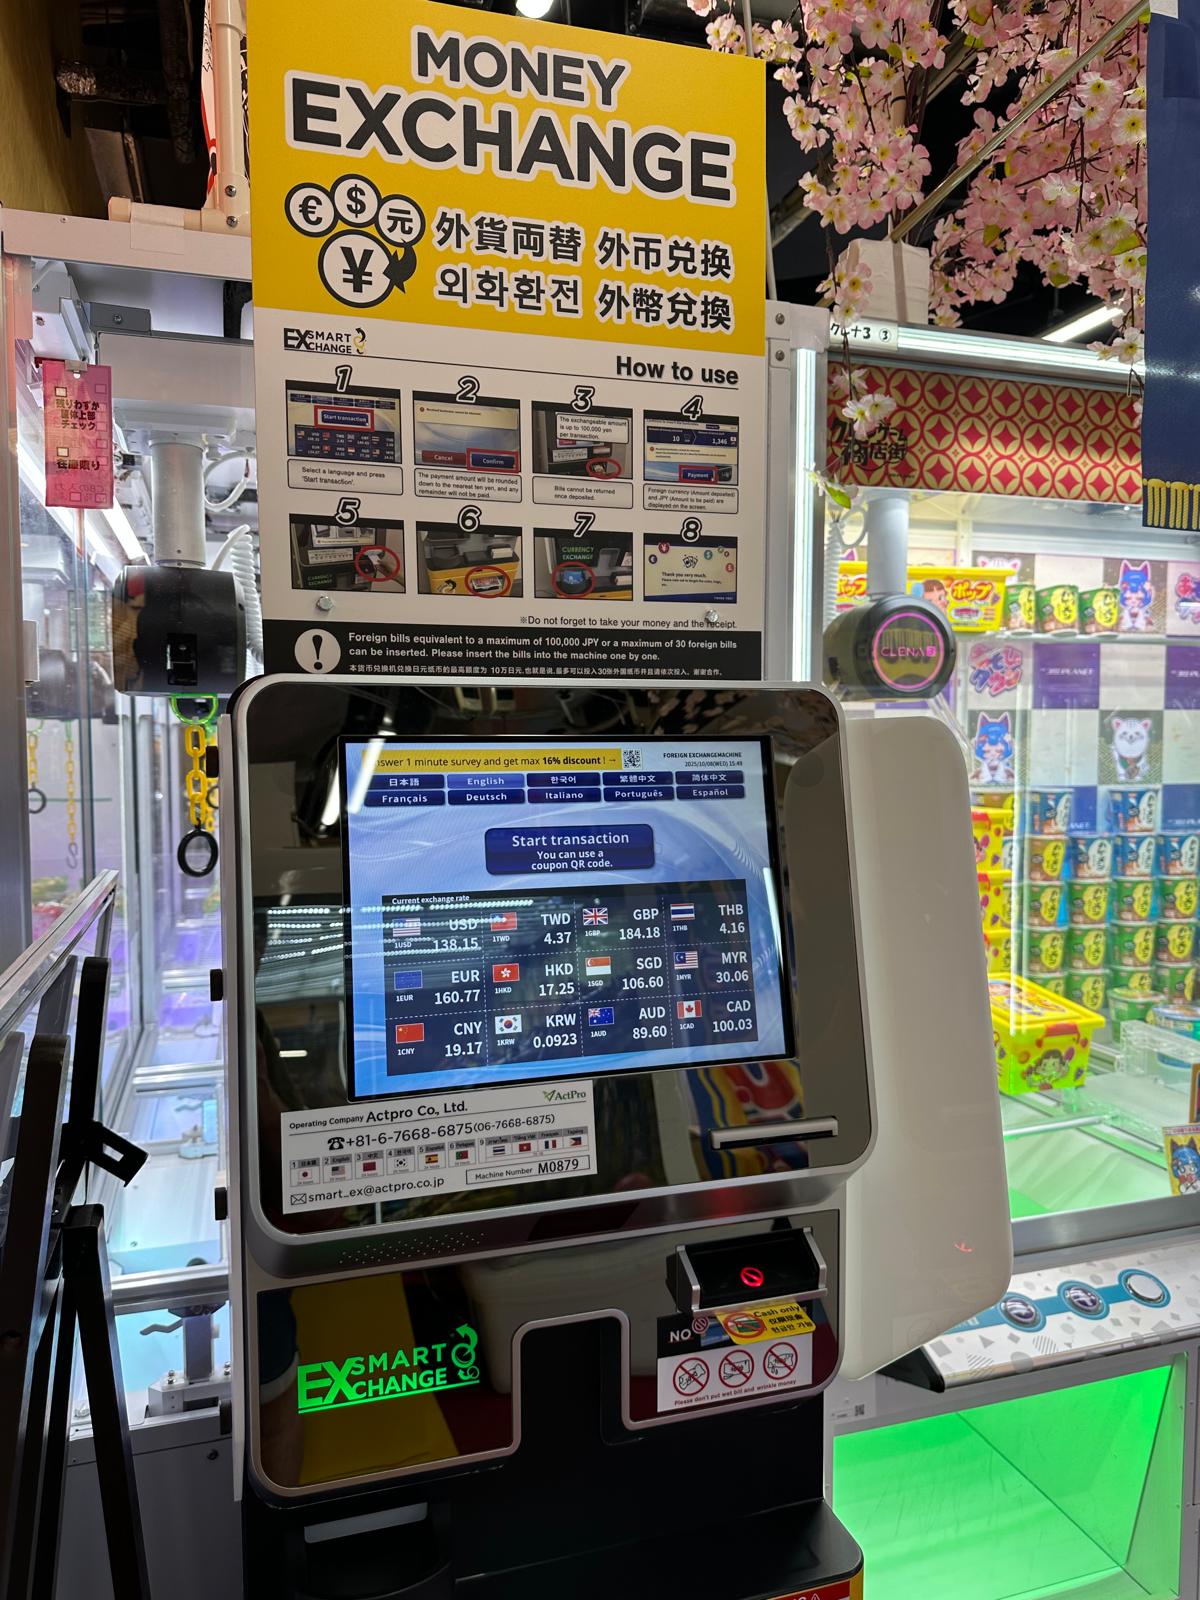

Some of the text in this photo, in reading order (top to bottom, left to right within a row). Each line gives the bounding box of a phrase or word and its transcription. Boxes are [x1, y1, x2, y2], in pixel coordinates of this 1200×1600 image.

[417, 31, 625, 106] MONEY
[292, 77, 731, 201] EXCHANGE
[384, 207, 414, 235] 元
[436, 211, 732, 280] 外貨両替 外币兑换
[437, 267, 580, 315] 외화환전
[598, 284, 732, 330] 外幣兌換
[308, 330, 351, 343] SMART
[616, 356, 739, 385] How to use
[336, 365, 352, 391] 1
[457, 376, 479, 402] 2
[572, 386, 594, 411] 3
[681, 395, 703, 420] 4
[336, 497, 360, 525] 5
[458, 505, 481, 532] 6
[574, 512, 595, 538] 7
[681, 517, 702, 542] 8
[952, 580, 993, 601] ポップ
[544, 617, 557, 625] not
[561, 617, 586, 628] forget
[589, 618, 597, 626] to
[600, 618, 619, 627] take
[621, 620, 640, 629] your
[643, 620, 670, 629] money
[673, 619, 689, 628] and
[692, 620, 705, 628] the
[706, 621, 737, 630] receipt.
[349, 632, 387, 644] Foreign
[390, 633, 410, 644] bills
[413, 634, 463, 645] equivalent
[465, 636, 475, 645] to
[486, 636, 531, 646] maximum
[533, 637, 544, 646] of
[545, 638, 580, 648] 100,000
[582, 638, 599, 647] JPY
[613, 640, 619, 648] a
[621, 638, 662, 648] maximum
[664, 638, 674, 648] of
[676, 639, 686, 648] 30
[688, 640, 718, 650] foreign
[720, 640, 738, 649] bills
[349, 648, 368, 656] can
[370, 648, 383, 656] be
[386, 648, 429, 658] inserted.
[431, 649, 463, 658] Please
[466, 649, 492, 658] insert
[495, 650, 508, 659] the
[512, 650, 531, 659] bills
[534, 650, 551, 660] into
[553, 651, 568, 660] the
[570, 651, 608, 660] machine
[629, 652, 640, 662] by
[880, 646, 926, 657] CLENA
[406, 758, 411, 767] 1
[415, 757, 448, 767] minute
[450, 758, 482, 768] survey
[484, 756, 501, 766] and
[504, 758, 519, 767] get
[521, 757, 540, 766] max
[542, 756, 560, 765] 16%
[562, 756, 601, 765] discount
[389, 778, 420, 787] 日本語
[467, 776, 505, 786] English
[550, 776, 577, 784] 한국어
[692, 774, 727, 782] 简体中文
[382, 794, 428, 804] Français
[466, 792, 507, 802] Deutsch
[546, 791, 584, 800] Italiano
[615, 790, 663, 800] Português
[692, 788, 728, 798] Español
[512, 832, 629, 847] Start transaction
[537, 850, 604, 860] You can use a
[531, 859, 613, 872] coupon QR code.
[392, 894, 470, 905] Current exchange rate
[633, 908, 659, 920] GBP
[718, 904, 744, 916] THB
[450, 918, 478, 931] USD
[541, 912, 571, 926] TWD
[619, 926, 661, 940] 184.18
[720, 922, 745, 934] 4.16
[433, 937, 479, 951] 138.15
[544, 932, 572, 945] 4.37
[636, 956, 663, 970] SGD
[722, 952, 748, 964] MYR
[545, 963, 574, 976] HKD
[716, 970, 749, 983] 30.06
[452, 970, 480, 984] EUR
[622, 976, 664, 990] 106.60
[538, 982, 575, 996] 17.25
[434, 990, 481, 1005] 160.77
[638, 1006, 666, 1020] AUD
[726, 1000, 751, 1012] CAD
[546, 1014, 576, 1028] KRW
[712, 1018, 753, 1032] 100.03
[454, 1022, 482, 1035] CNY
[632, 1026, 668, 1040] 89.60
[533, 1033, 578, 1048] 0.0923
[444, 1042, 483, 1057] 19.17
[554, 1090, 586, 1101] ActPro
[289, 1101, 468, 1130] Operating Company Actpro Co., Ltd.
[475, 1158, 579, 1181] Machine Number M0879
[308, 1176, 445, 1203] smart_ex@actpro.co.jp
[754, 1308, 778, 1318] Cash
[780, 1305, 800, 1315] only
[670, 1328, 692, 1343] NO
[351, 1343, 447, 1375] SMART
[351, 1367, 448, 1399] CHANGE
[674, 1398, 693, 1406] Please
